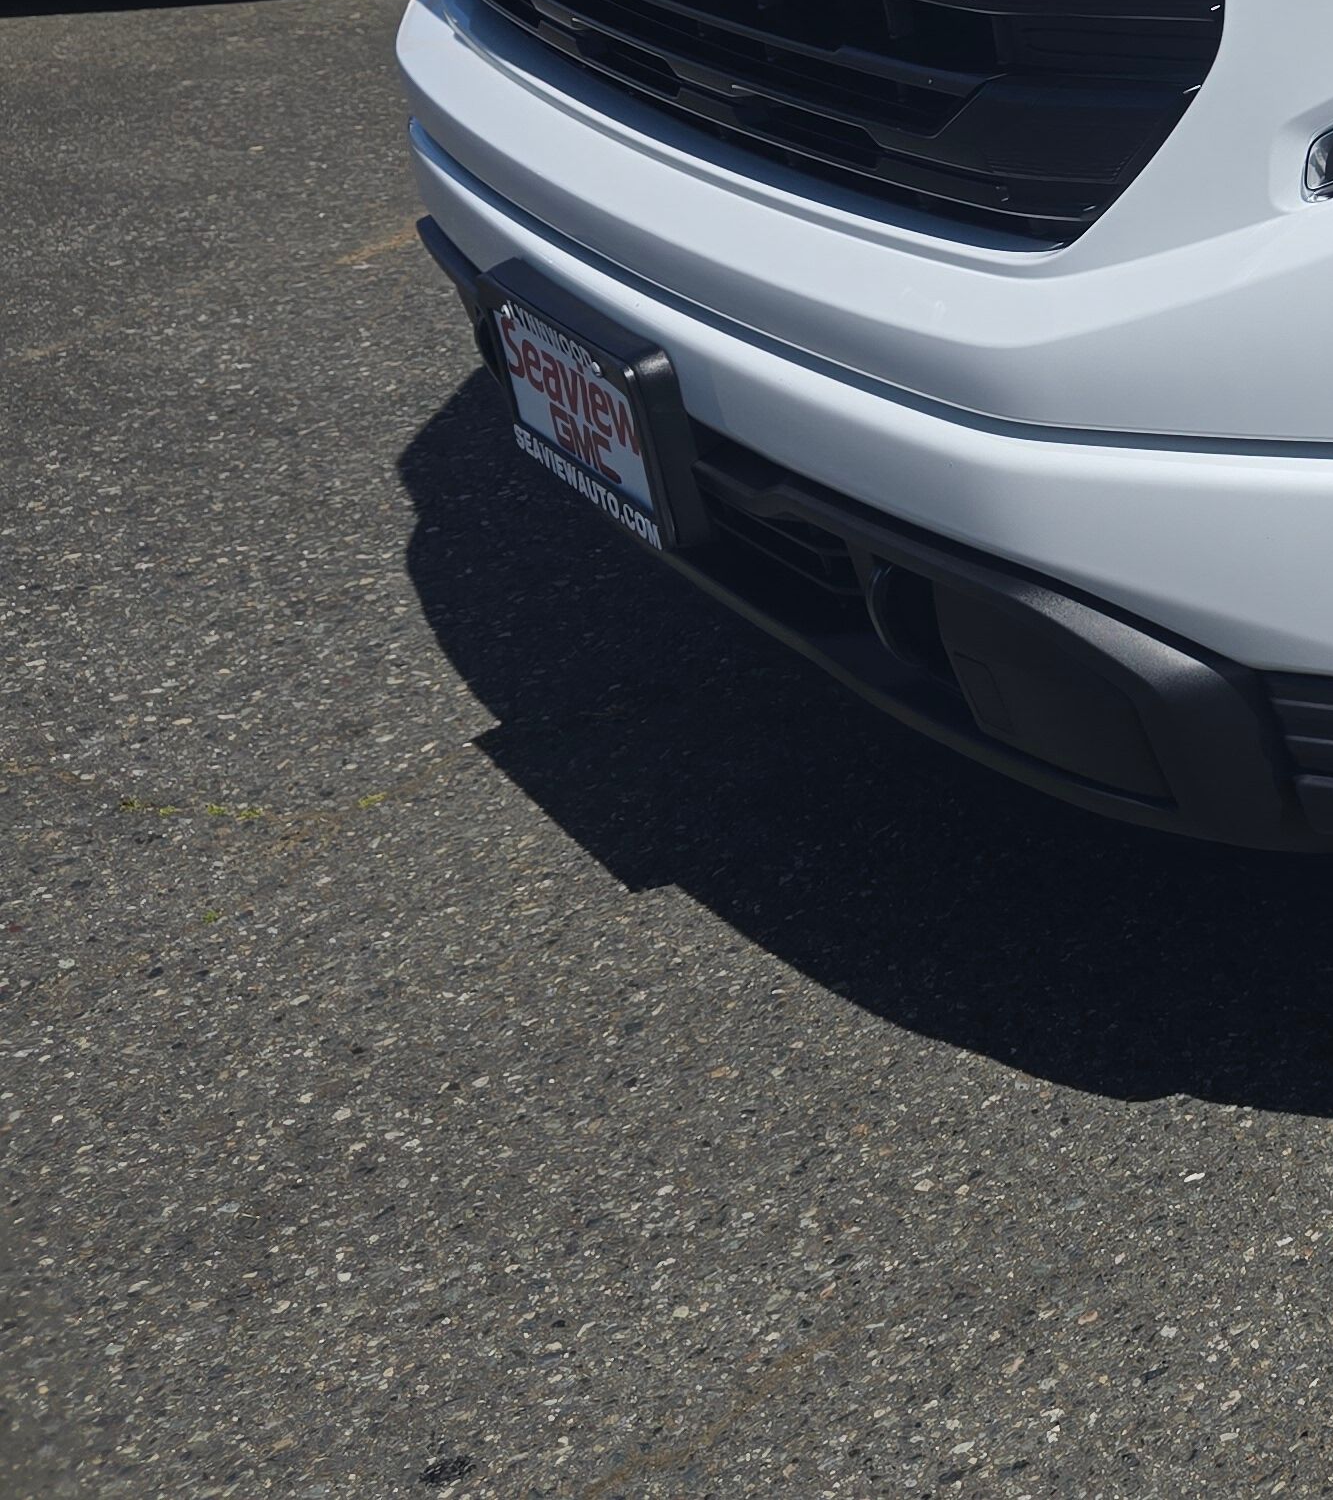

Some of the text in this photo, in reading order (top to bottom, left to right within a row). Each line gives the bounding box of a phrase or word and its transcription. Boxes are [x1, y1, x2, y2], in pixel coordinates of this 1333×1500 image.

[500, 316, 640, 457] Seaview
[550, 403, 622, 485] GMC
[513, 423, 663, 551] SEAVIEWAUTO.COM
